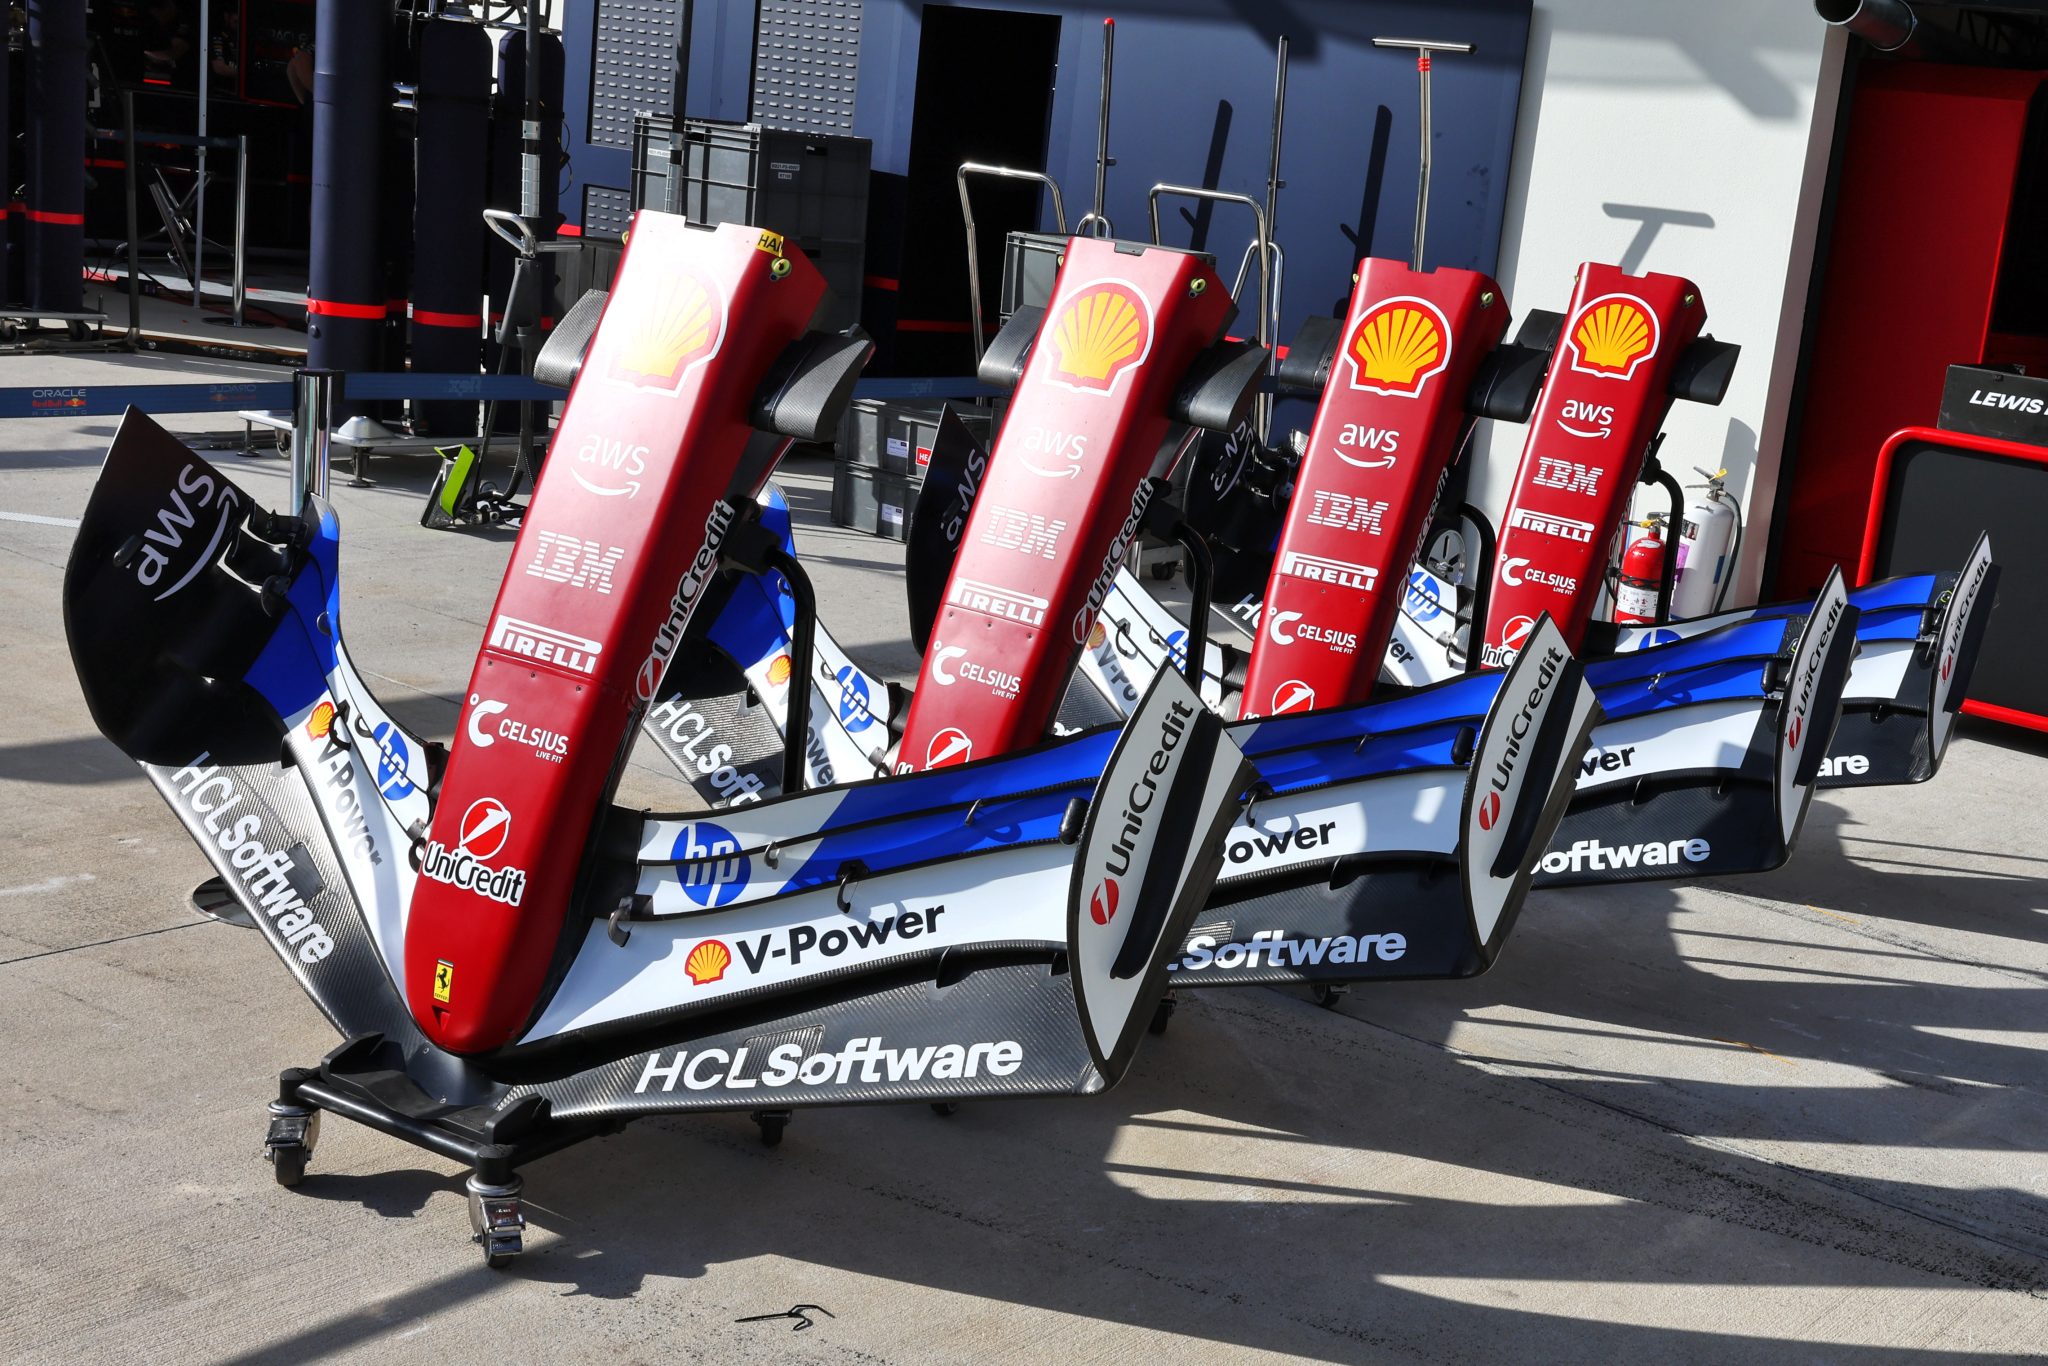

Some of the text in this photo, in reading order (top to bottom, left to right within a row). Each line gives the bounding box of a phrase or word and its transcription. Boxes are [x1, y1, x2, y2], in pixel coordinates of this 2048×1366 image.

[32, 388, 87, 398] ORACLE
[1561, 399, 1615, 426] aws
[1969, 389, 2045, 414] LEWIS
[578, 433, 651, 476] aws
[1023, 425, 1088, 460] aws
[1338, 423, 1399, 454] aws
[1532, 456, 1604, 497] IBM
[137, 463, 215, 586] aws
[979, 504, 1067, 560] IBM
[1306, 490, 1390, 536] IBM
[1511, 508, 1595, 543] PIRELLI
[525, 529, 625, 595] IBM
[1088, 478, 1155, 613] UniCredit
[1281, 551, 1379, 592] PIRELLI
[652, 499, 738, 658] UniCredit
[947, 577, 1049, 626] PIRELLI
[1947, 556, 1989, 657] UniCredit
[488, 614, 603, 674] PIRELLI
[1330, 645, 1353, 655] LIVE FIT
[1795, 596, 1844, 716] UniCredit
[992, 688, 1017, 701] LIVE FIT
[1491, 646, 1565, 792] UniCredit
[535, 749, 563, 764] LIVE FIT
[316, 735, 382, 868] V-Power
[1104, 699, 1195, 878] UniCredit
[170, 751, 335, 964] HCLSoftware
[424, 840, 526, 905] UniCredit
[679, 822, 746, 907] hp
[736, 904, 945, 975] V-Power
[633, 1036, 1023, 1094] HCLSoftware
